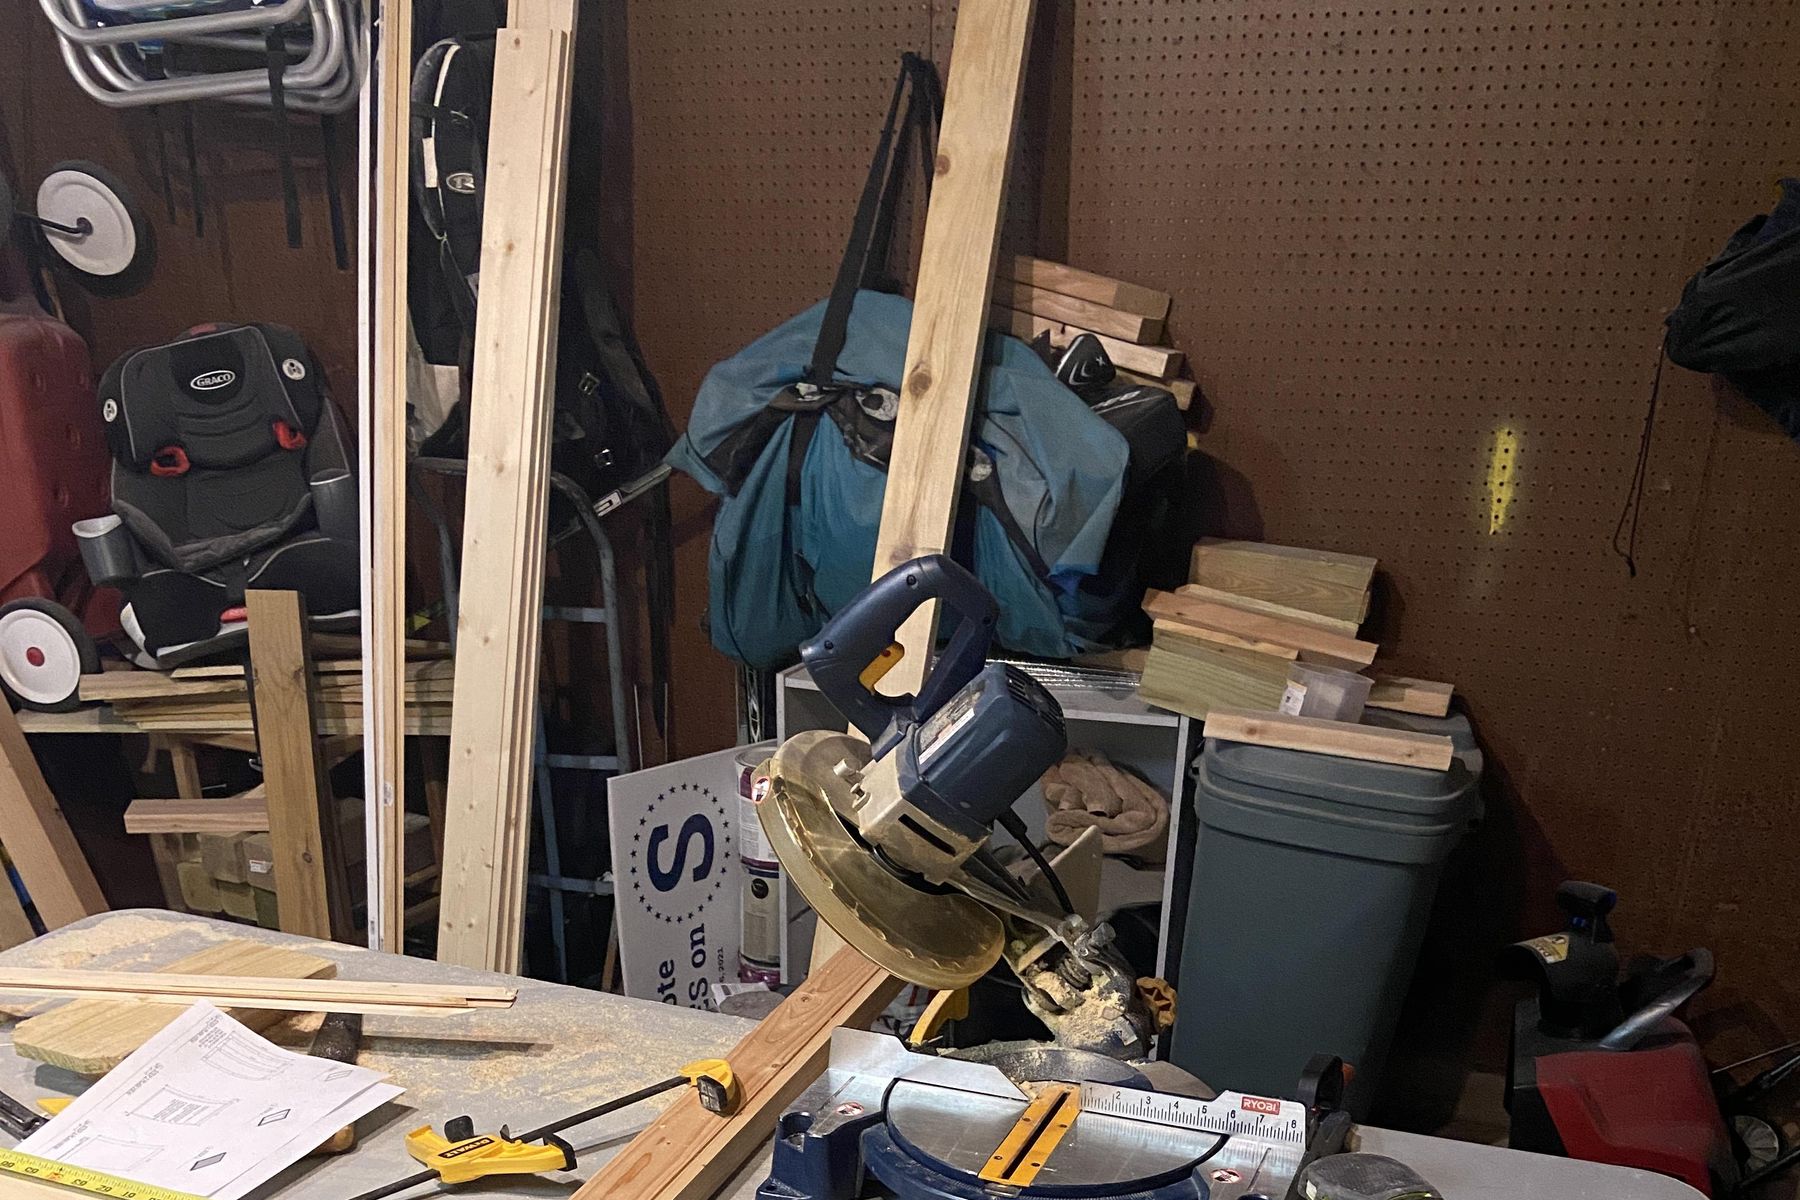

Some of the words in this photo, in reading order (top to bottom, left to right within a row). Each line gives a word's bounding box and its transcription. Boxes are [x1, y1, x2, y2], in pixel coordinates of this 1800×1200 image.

[197, 374, 231, 386] GRACO
[647, 814, 714, 892] S
[688, 923, 706, 968] on
[716, 947, 724, 971] 2021
[1116, 1091, 1121, 1100] 2
[1146, 1096, 1152, 1105] 3
[1173, 1101, 1179, 1109] 4
[1201, 1105, 1208, 1114] 5
[1230, 1110, 1236, 1119] 6
[1259, 1114, 1265, 1123] 7
[1291, 1120, 1297, 1128] 8
[1243, 1098, 1279, 1113] RYOBI
[24, 1166, 39, 1174] 65
[71, 1178, 88, 1187] 63
[95, 1185, 113, 1193] 62
[121, 1191, 136, 1199] 61
